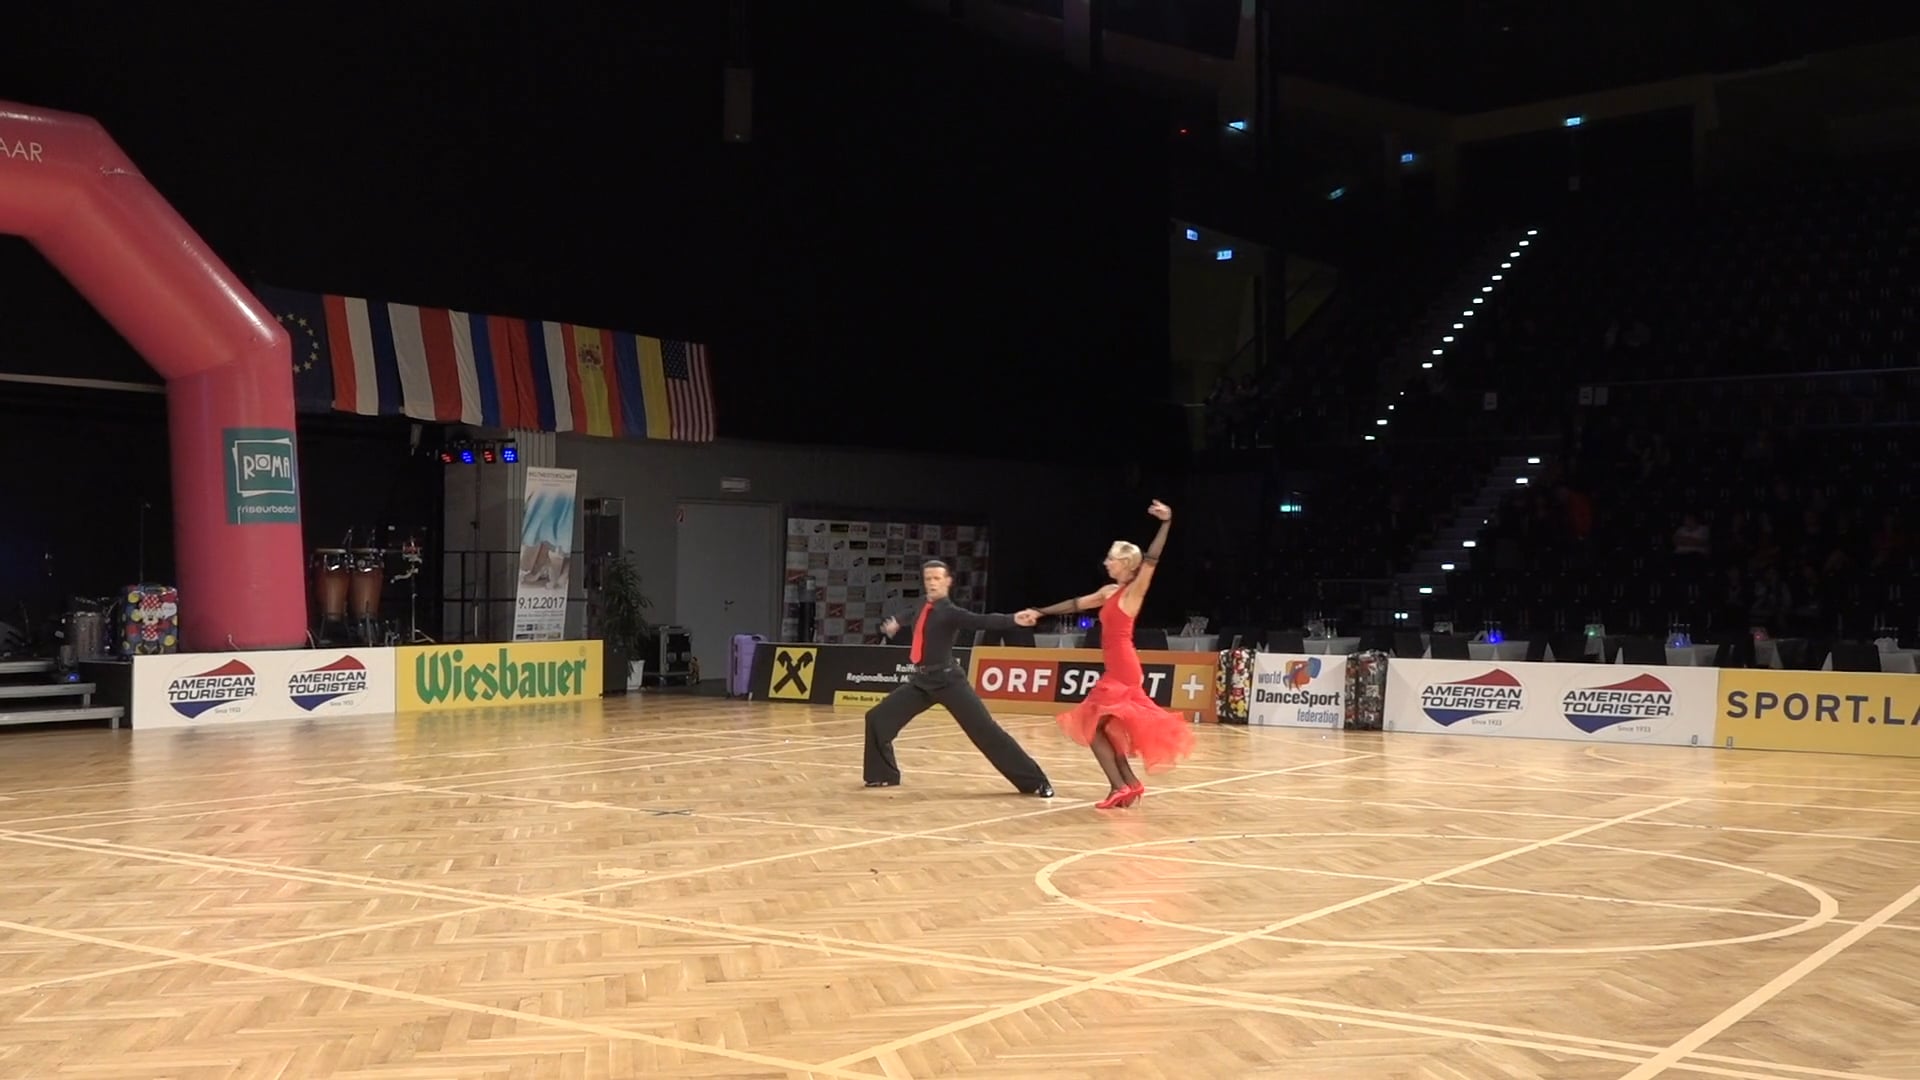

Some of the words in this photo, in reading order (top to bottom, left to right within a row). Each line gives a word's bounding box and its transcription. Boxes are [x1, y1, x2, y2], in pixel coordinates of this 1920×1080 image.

[243, 454, 290, 480] ROMA
[518, 597, 565, 609] 9.12.2017
[169, 676, 256, 690] AMERICAN
[288, 671, 367, 684] AMERICAN
[416, 648, 587, 704] Wiesbauer
[846, 672, 899, 683] Regionalbank
[981, 667, 1052, 693] ORF
[1060, 669, 1166, 698] SPT
[1258, 671, 1282, 684] world
[168, 686, 256, 701] TOURISTER
[288, 681, 367, 695] TOURISTER
[1422, 685, 1522, 699] AMERICAN
[1256, 689, 1341, 707] DanceSport
[1421, 696, 1522, 710] TOURISTER
[1563, 690, 1673, 705] AMERICAN
[1297, 709, 1339, 724] federation
[1562, 702, 1672, 717] TOURISTER
